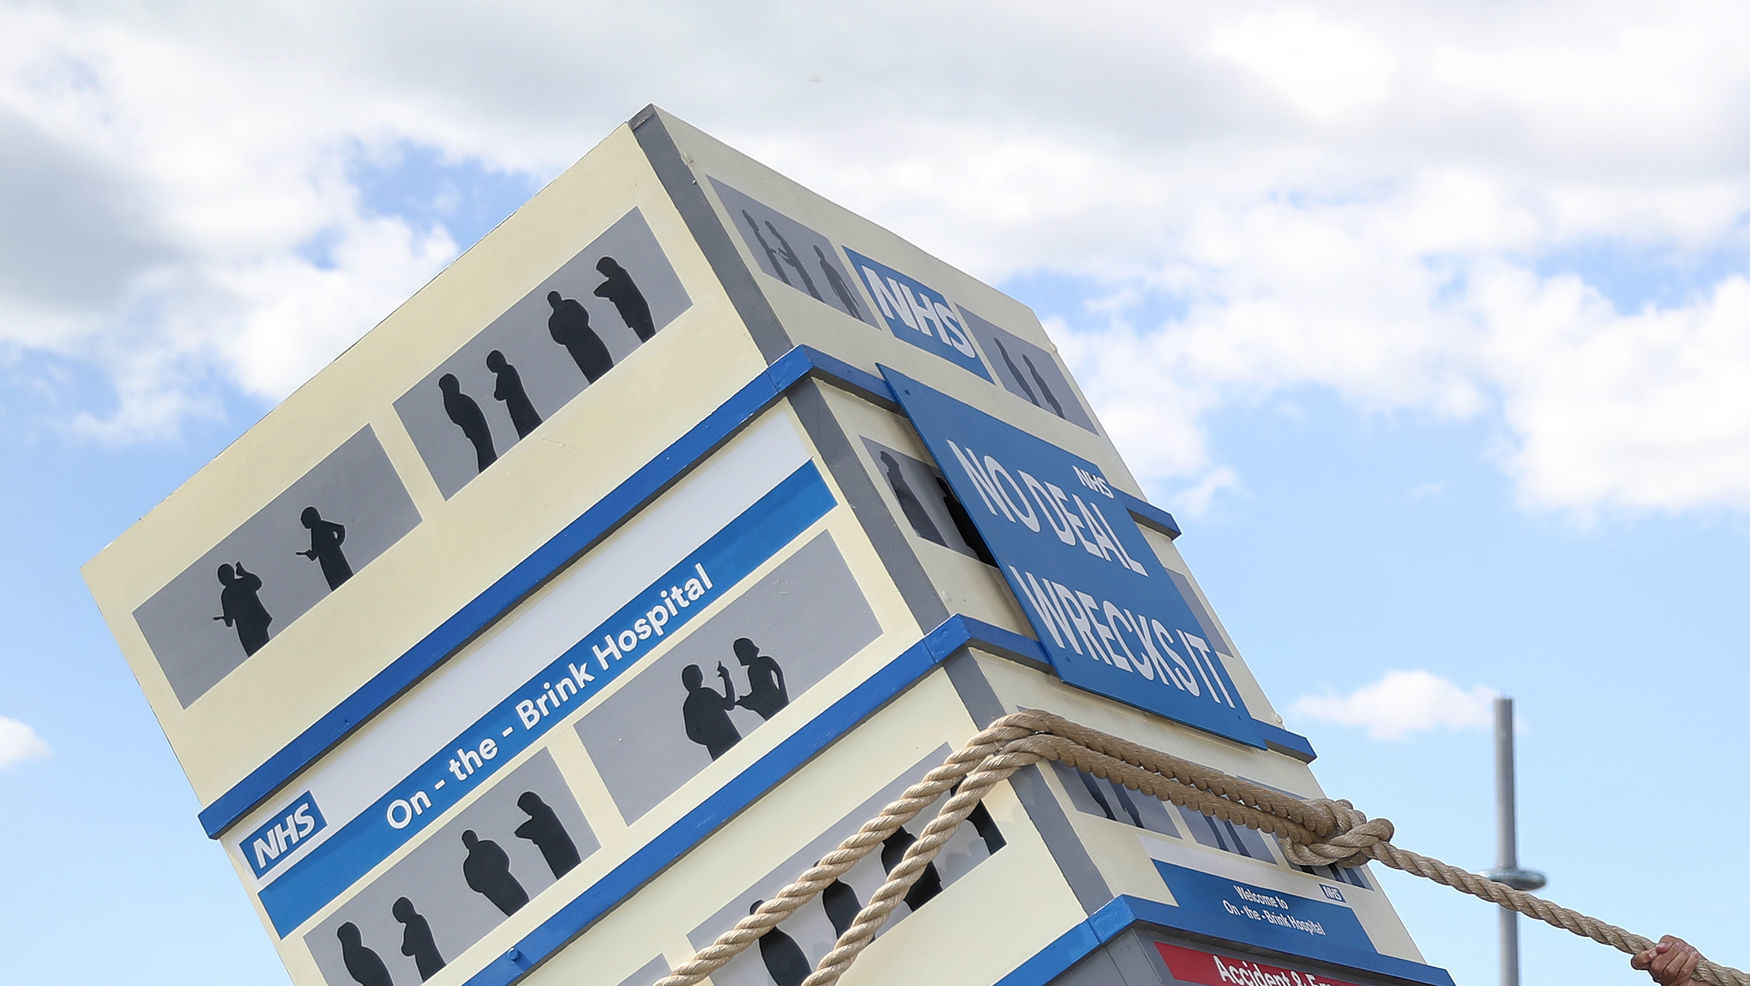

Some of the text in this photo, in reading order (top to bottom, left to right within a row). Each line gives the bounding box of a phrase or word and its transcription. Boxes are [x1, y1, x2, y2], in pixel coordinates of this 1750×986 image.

[861, 265, 976, 358] NHS
[946, 439, 1149, 577] NO DEAL
[1072, 465, 1115, 499] NHS
[1008, 565, 1236, 709] WRECKS IT
[386, 790, 432, 829] On
[448, 748, 498, 781] the
[515, 662, 595, 730] Brink
[591, 562, 713, 671] Hospital
[253, 802, 315, 869] NHS
[1222, 899, 1240, 916] On
[1244, 905, 1261, 921] the
[1263, 909, 1291, 928] Brink
[1288, 914, 1326, 936] Hospital
[1233, 885, 1288, 910] Welcome to
[1322, 886, 1343, 900] NHS
